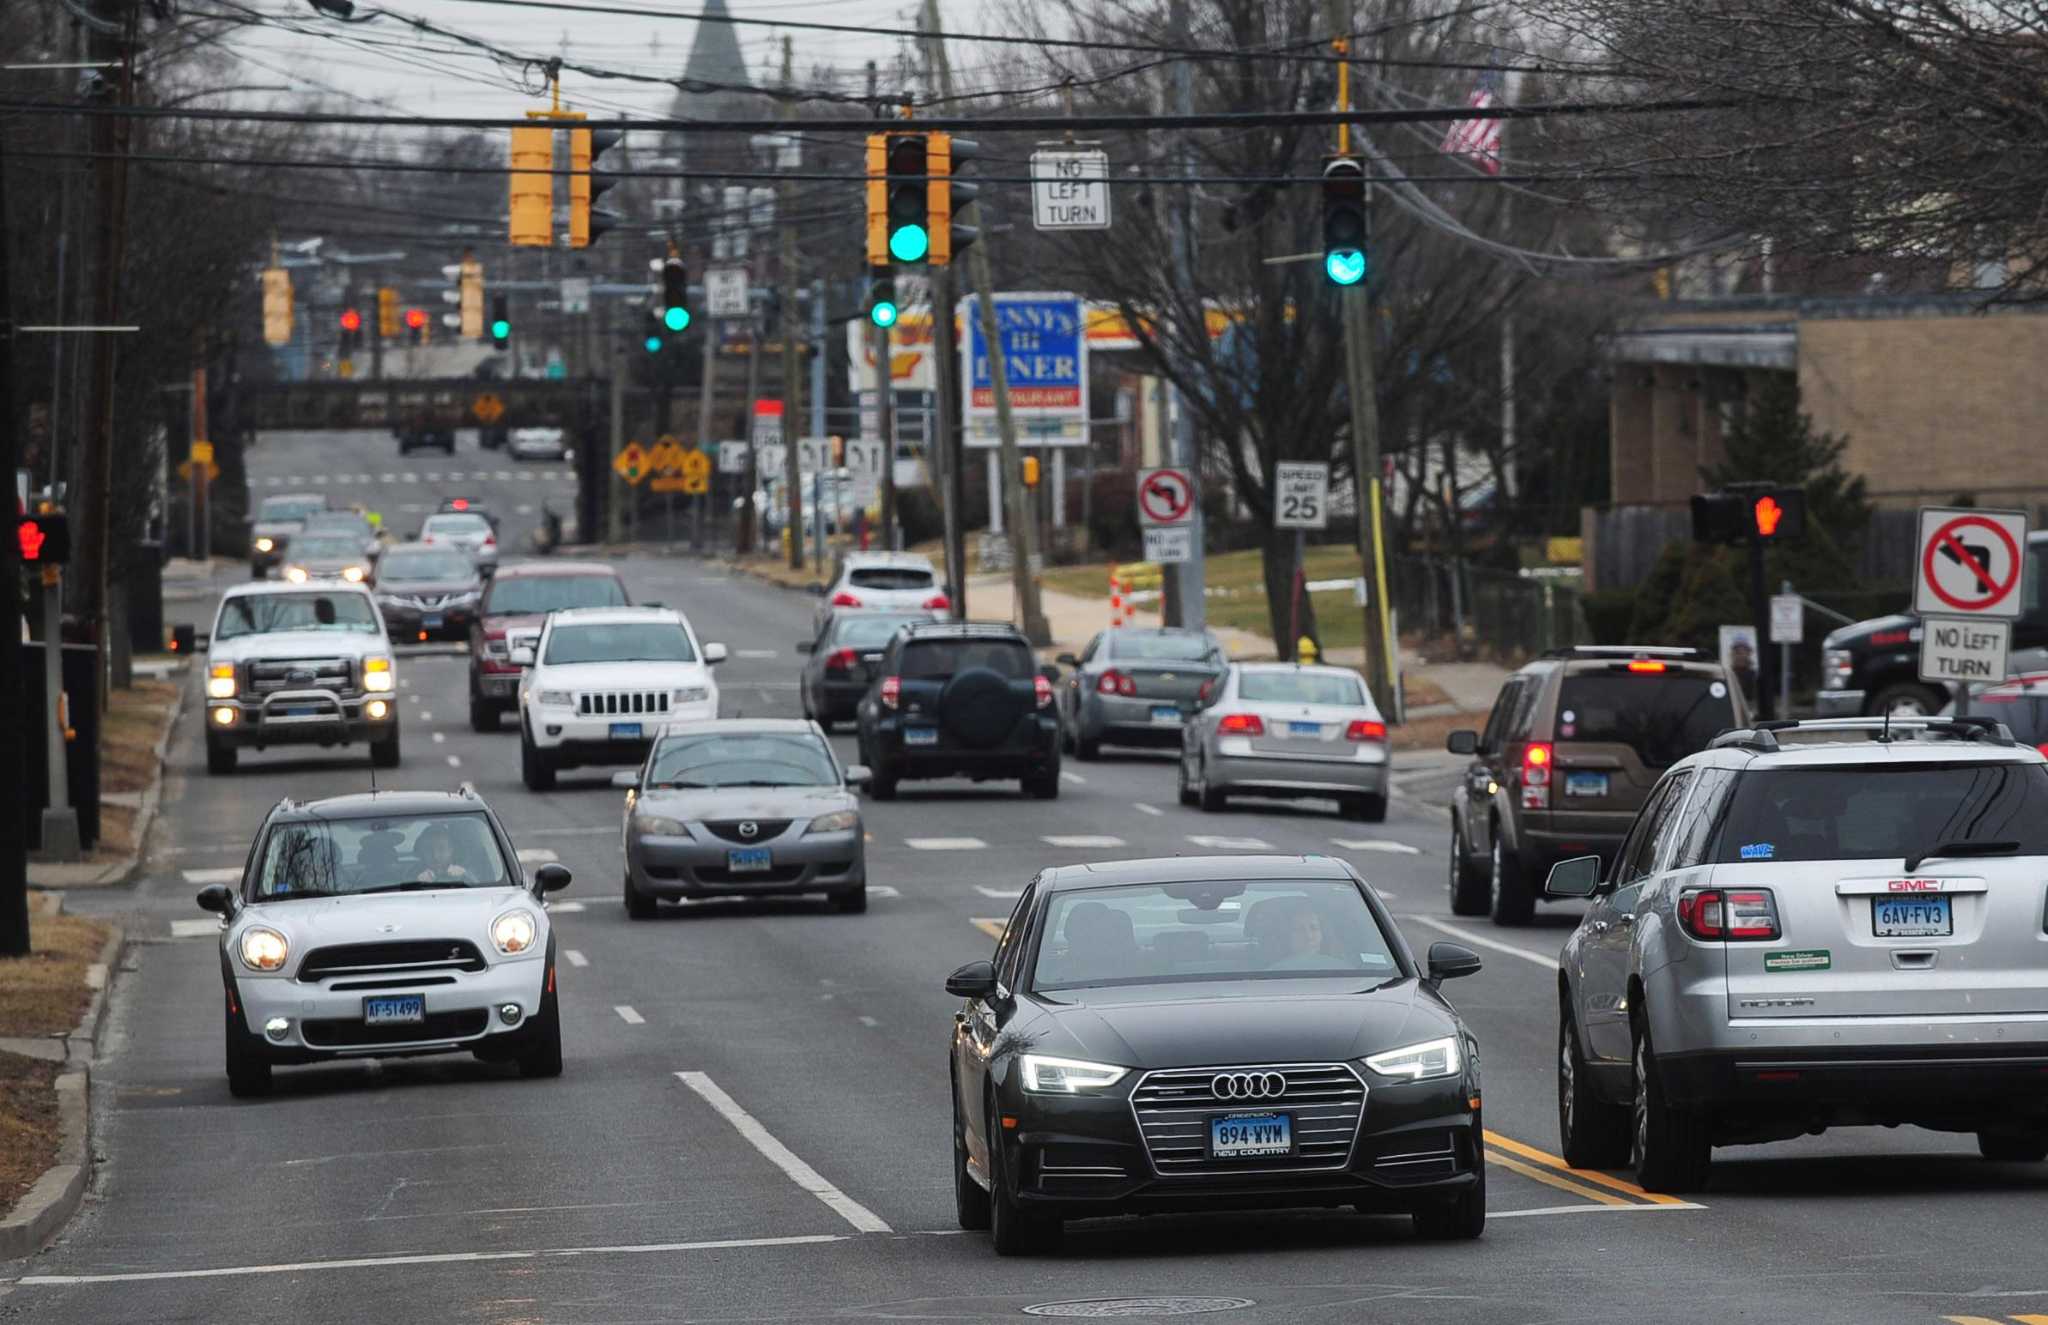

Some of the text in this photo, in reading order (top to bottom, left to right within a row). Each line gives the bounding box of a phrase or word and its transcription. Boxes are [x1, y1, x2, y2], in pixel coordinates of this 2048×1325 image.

[1056, 160, 1082, 177] NO
[1048, 181, 1091, 199] LEFT
[1047, 206, 1097, 223] TURN
[1280, 471, 1323, 480] SPEED
[1283, 496, 1318, 519] 25
[1935, 627, 2000, 651] NO LEFT
[1936, 656, 1992, 676] TURN
[1888, 880, 1938, 892] GMC
